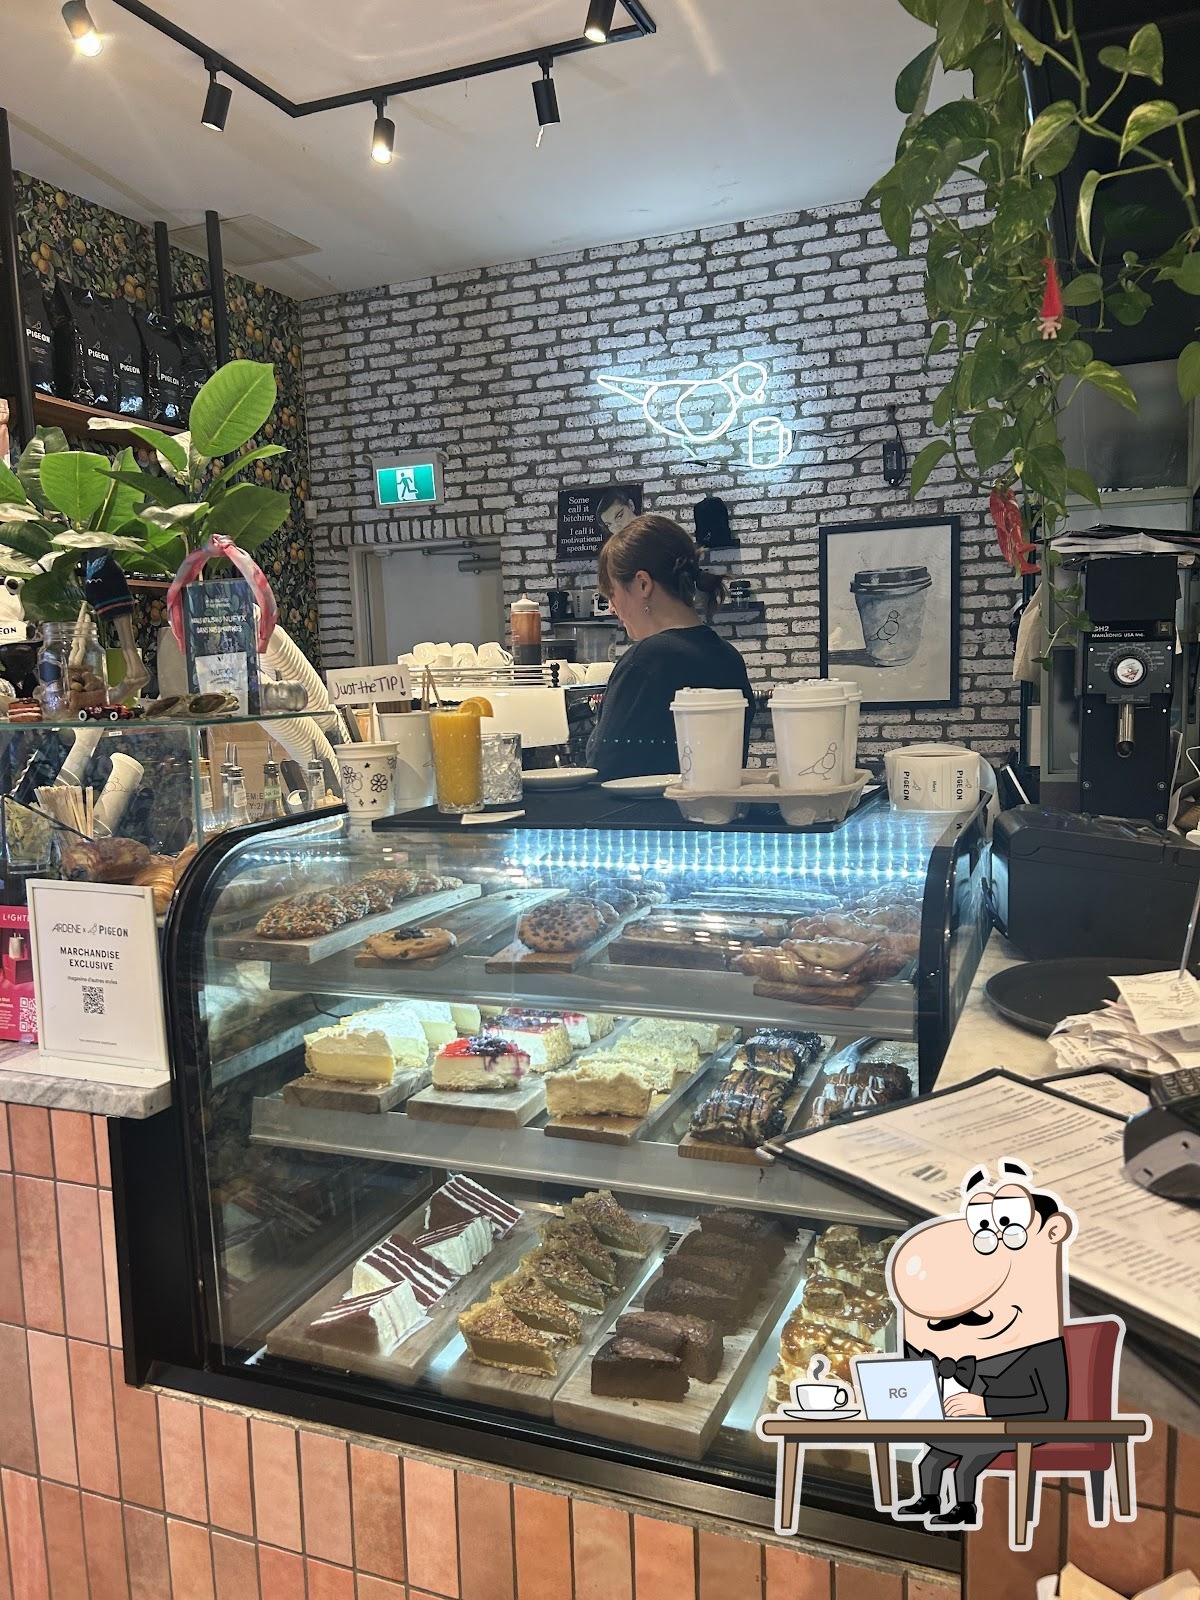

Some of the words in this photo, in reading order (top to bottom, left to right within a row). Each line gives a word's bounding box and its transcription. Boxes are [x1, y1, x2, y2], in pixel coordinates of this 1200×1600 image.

[26, 328, 51, 343] PIGEON
[87, 348, 109, 362] PIGEON
[119, 362, 141, 375] PIGEON
[160, 373, 180, 386] PIGEON
[568, 496, 590, 505] Some
[567, 505, 582, 514] call
[583, 504, 590, 512] it
[563, 513, 596, 523] bitching.
[574, 527, 588, 535] call
[588, 526, 595, 535] it
[560, 534, 603, 544] motivational
[566, 544, 599, 553] speaking.
[956, 770, 964, 800] PIGEON
[52, 922, 81, 934] ARDENE
[98, 925, 129, 937] PIGEON
[60, 946, 120, 960] MARCHANDISE
[69, 959, 114, 971] EXCLUSIVE
